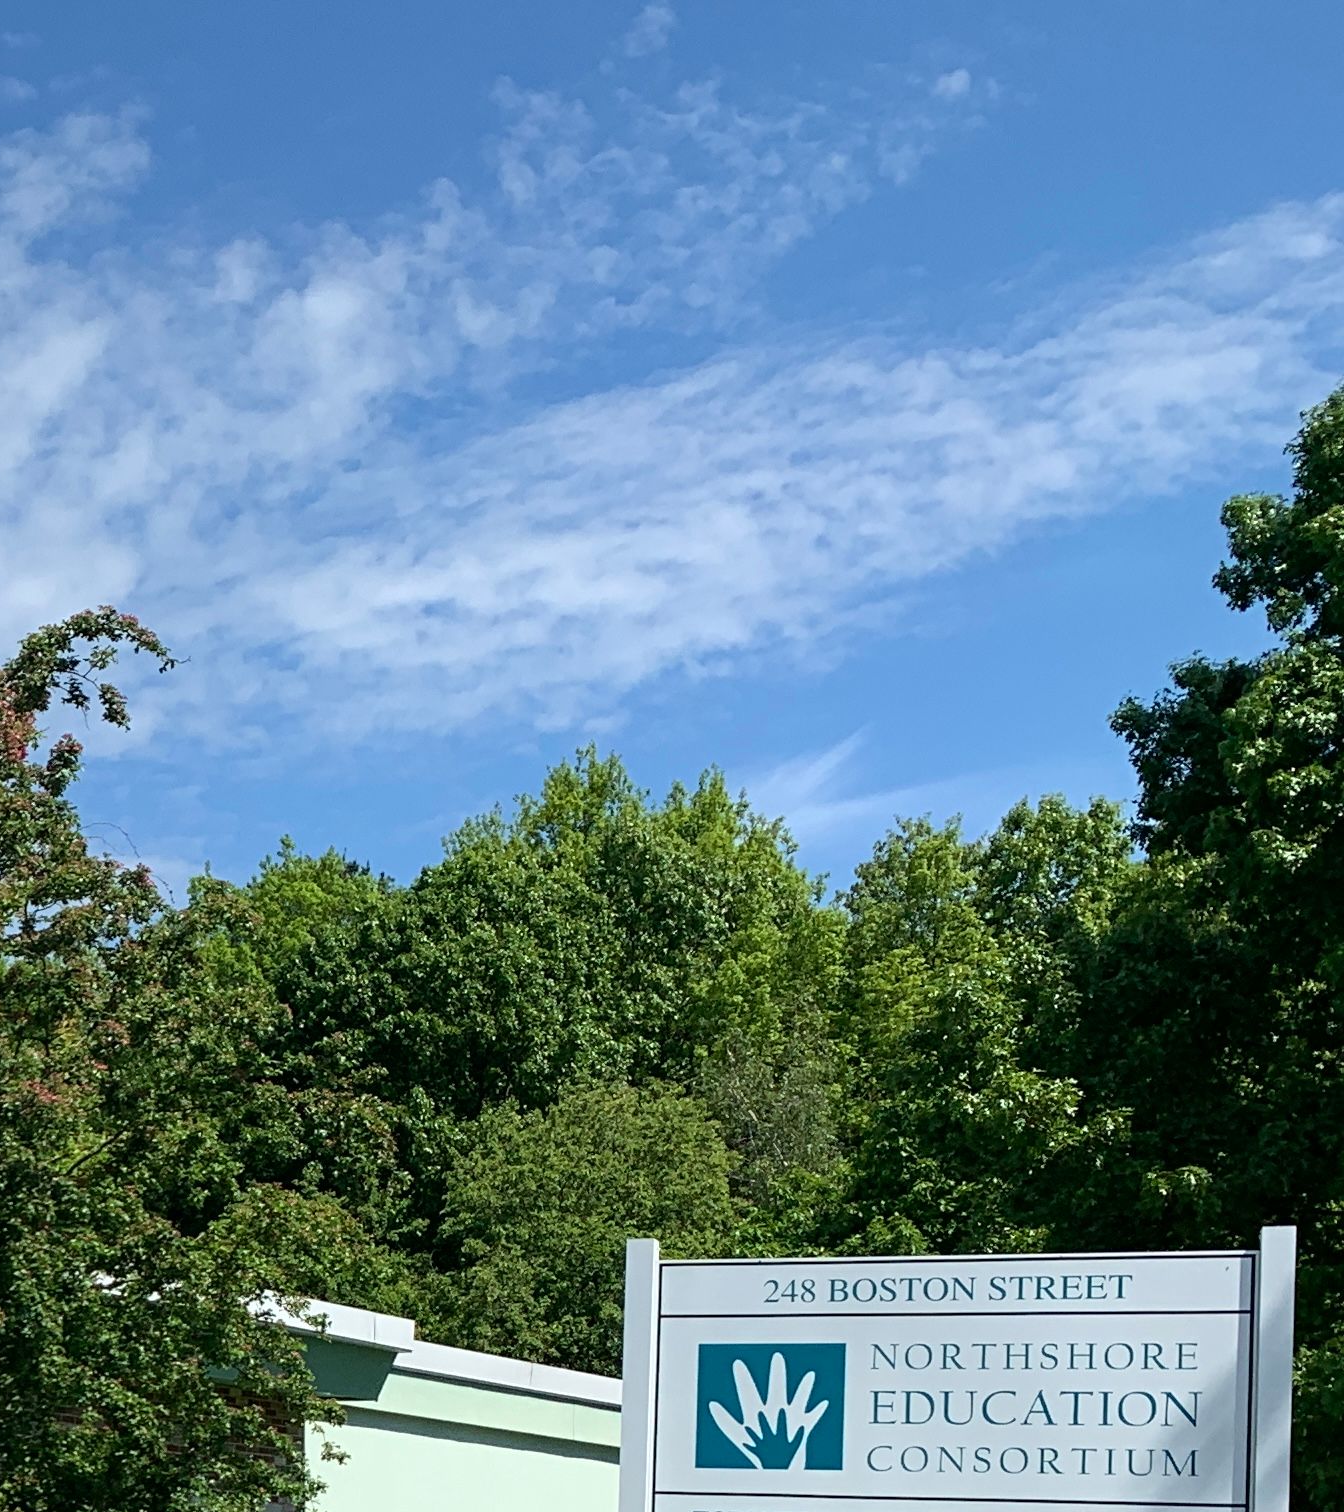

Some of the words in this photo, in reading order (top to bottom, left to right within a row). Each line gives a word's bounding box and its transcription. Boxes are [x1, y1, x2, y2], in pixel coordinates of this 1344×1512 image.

[763, 1278, 816, 1304] 248
[828, 1276, 977, 1303] BOSTON
[988, 1273, 1133, 1301] STREET
[870, 1342, 1199, 1371] NORTHSHORE
[868, 1389, 1203, 1428] EDUCATION
[866, 1445, 1200, 1478] CONSORTIUM
